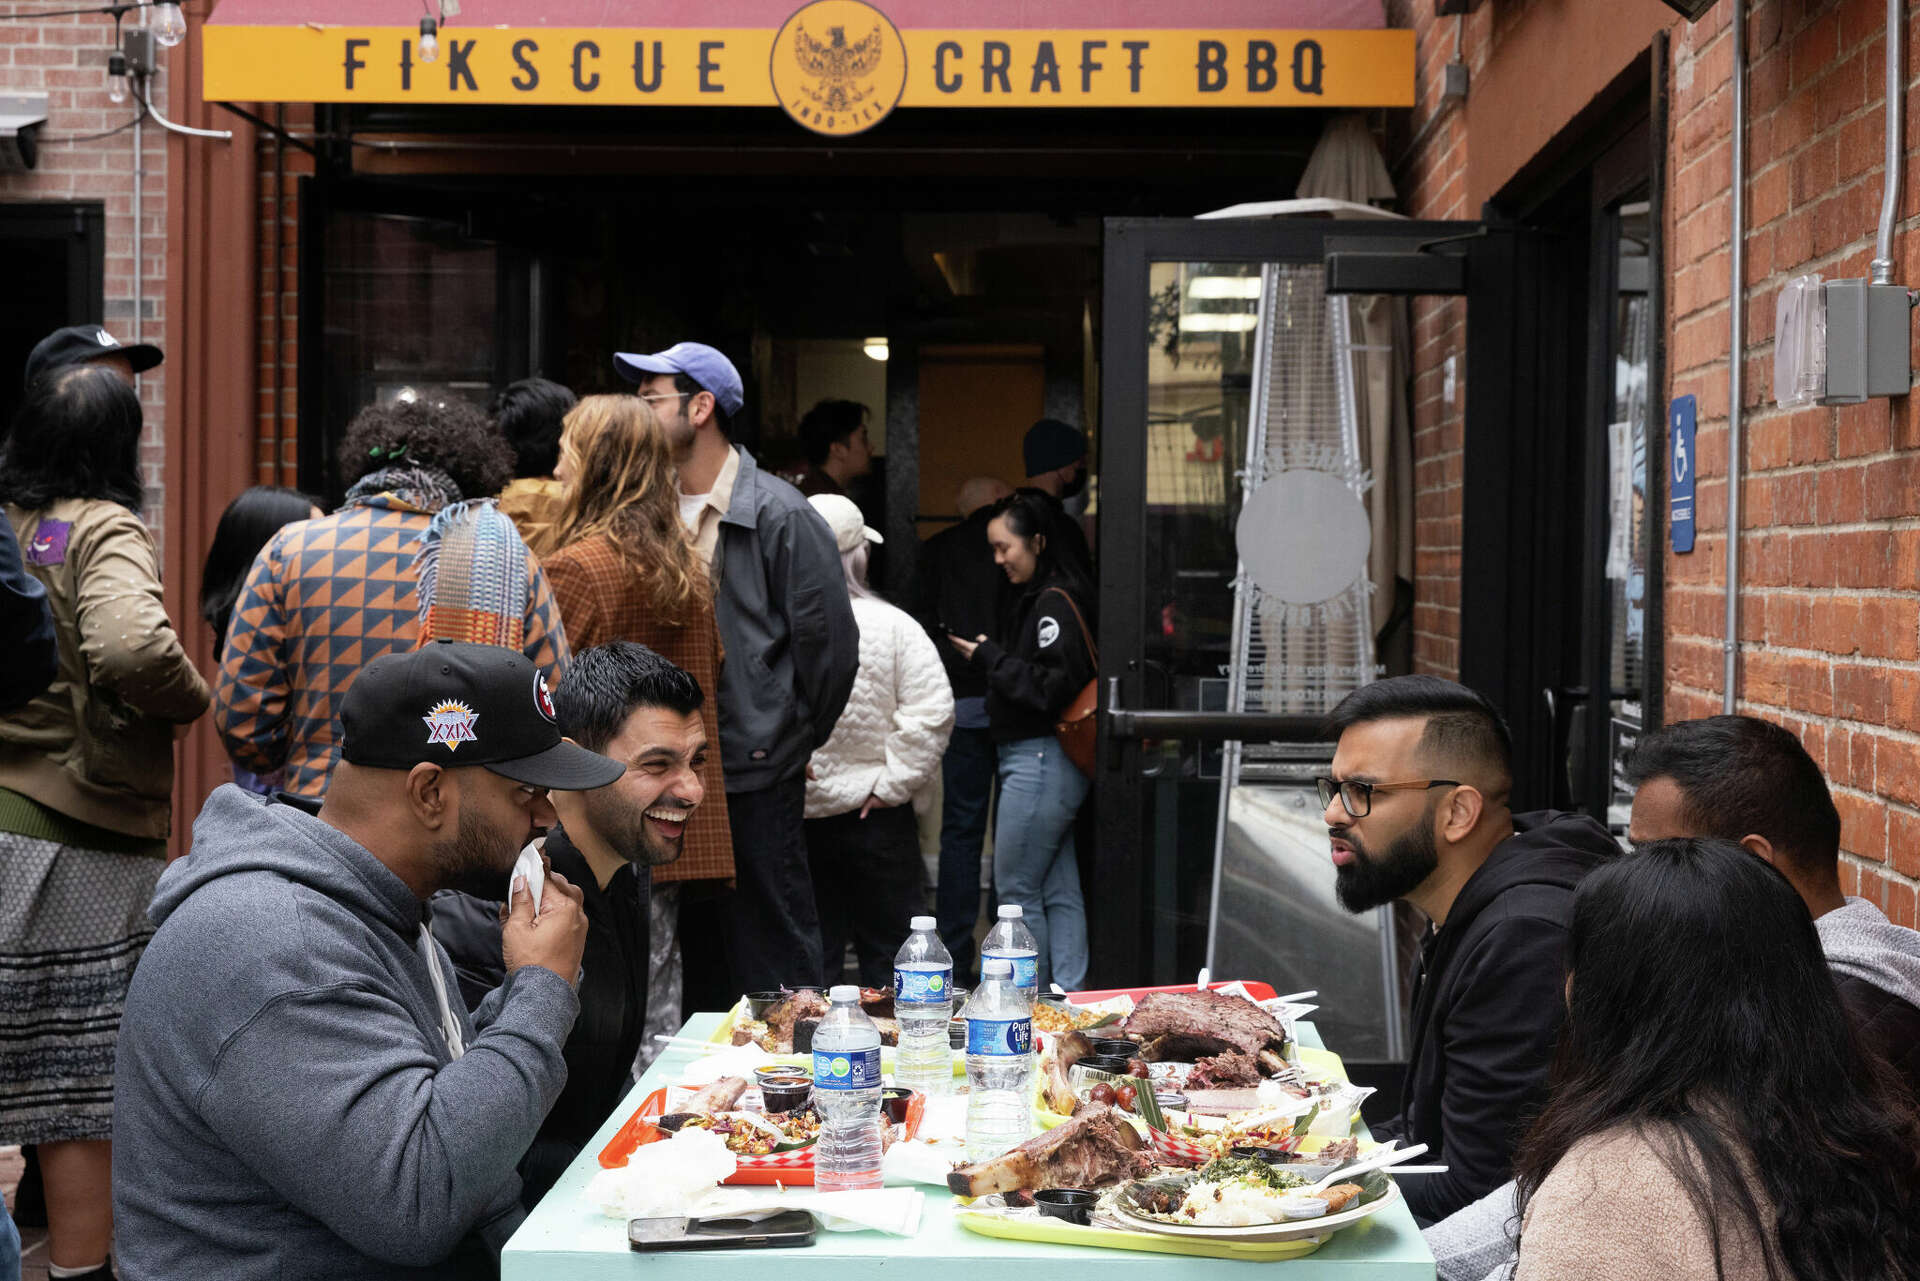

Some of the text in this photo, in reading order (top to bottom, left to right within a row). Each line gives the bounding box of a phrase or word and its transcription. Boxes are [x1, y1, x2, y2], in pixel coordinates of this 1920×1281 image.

[342, 38, 1326, 96] FIKSCUE CRAFT BBQ
[427, 717, 474, 741] XXIX
[1012, 1021, 1030, 1032] Pure
[1014, 1031, 1029, 1043] Life
